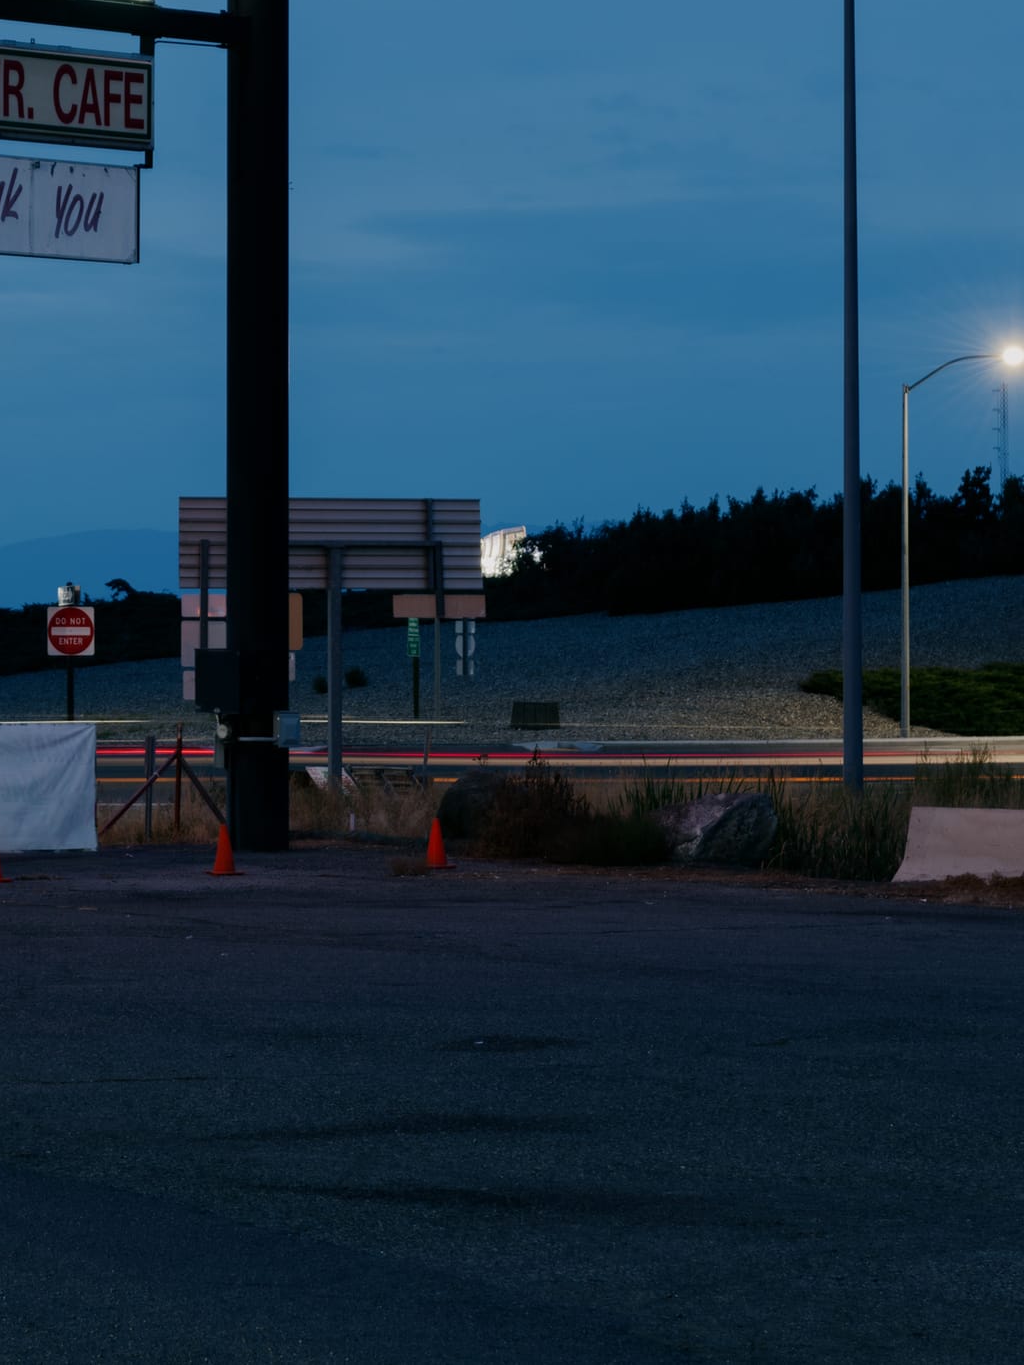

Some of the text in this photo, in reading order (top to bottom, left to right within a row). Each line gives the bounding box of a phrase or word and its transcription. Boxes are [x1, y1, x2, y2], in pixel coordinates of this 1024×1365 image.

[53, 64, 145, 129] CAFE
[54, 183, 104, 239] You
[55, 617, 86, 625] DO NOT
[58, 637, 83, 646] ENTER
